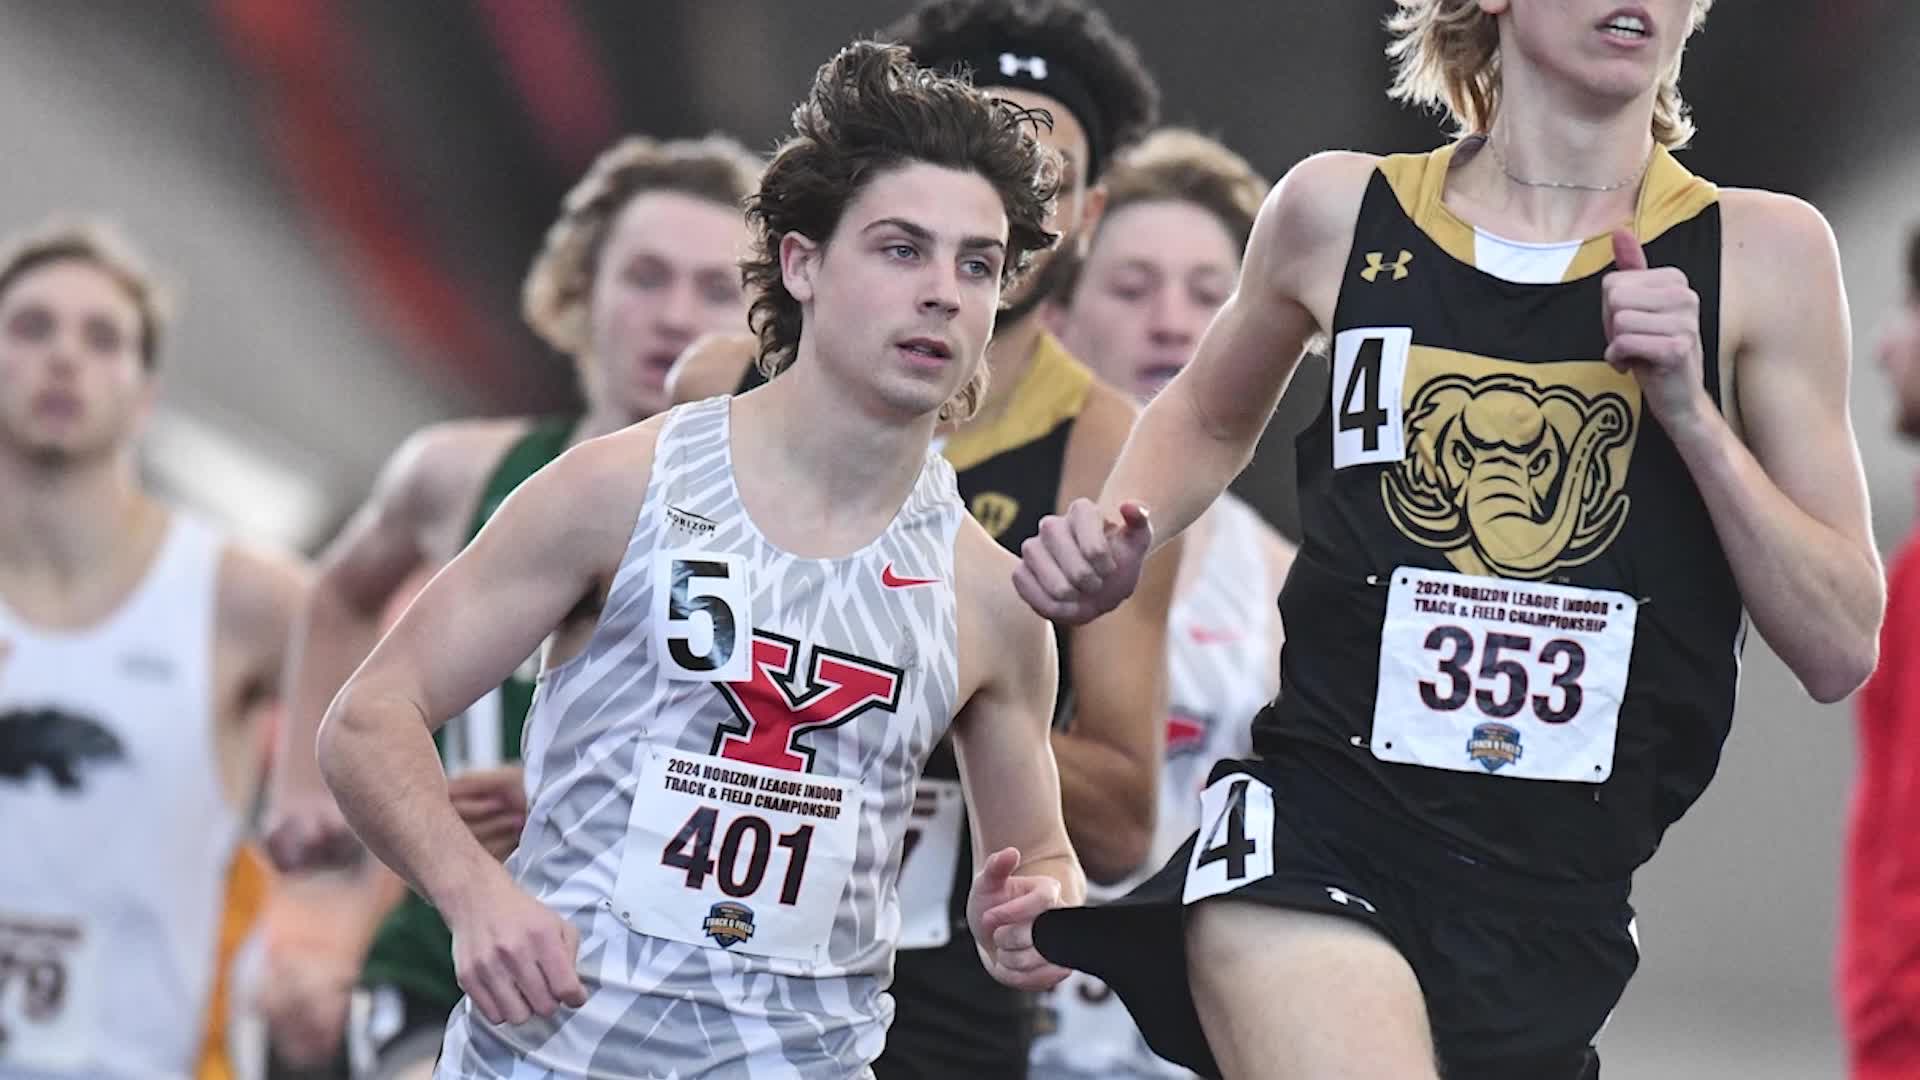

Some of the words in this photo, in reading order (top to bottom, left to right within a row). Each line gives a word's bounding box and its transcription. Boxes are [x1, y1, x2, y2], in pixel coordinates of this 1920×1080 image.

[1339, 337, 1388, 451] 4
[667, 560, 736, 672] 5
[1414, 599, 1456, 615] TRACK
[1460, 605, 1469, 617] &
[1472, 606, 1505, 621] FIELD
[1509, 611, 1607, 632] CHAMPIONSHIP
[1416, 580, 1449, 595] 2024
[1453, 584, 1509, 602] HORIZON
[1513, 592, 1559, 609] LEAGUE
[1563, 599, 1609, 615] INDOOR
[711, 628, 904, 773] Y
[1417, 624, 1586, 724] 353
[664, 776, 706, 796] TRACK
[708, 786, 718, 799] &
[720, 788, 753, 805] FIELD
[755, 794, 840, 820] CHAMPIONSHIP
[667, 758, 700, 777] 2024
[703, 766, 758, 787] HORIZON
[760, 777, 802, 796] LEAGUE
[804, 785, 842, 802] INDOOR
[1196, 780, 1255, 880] 4
[661, 806, 814, 906] 401
